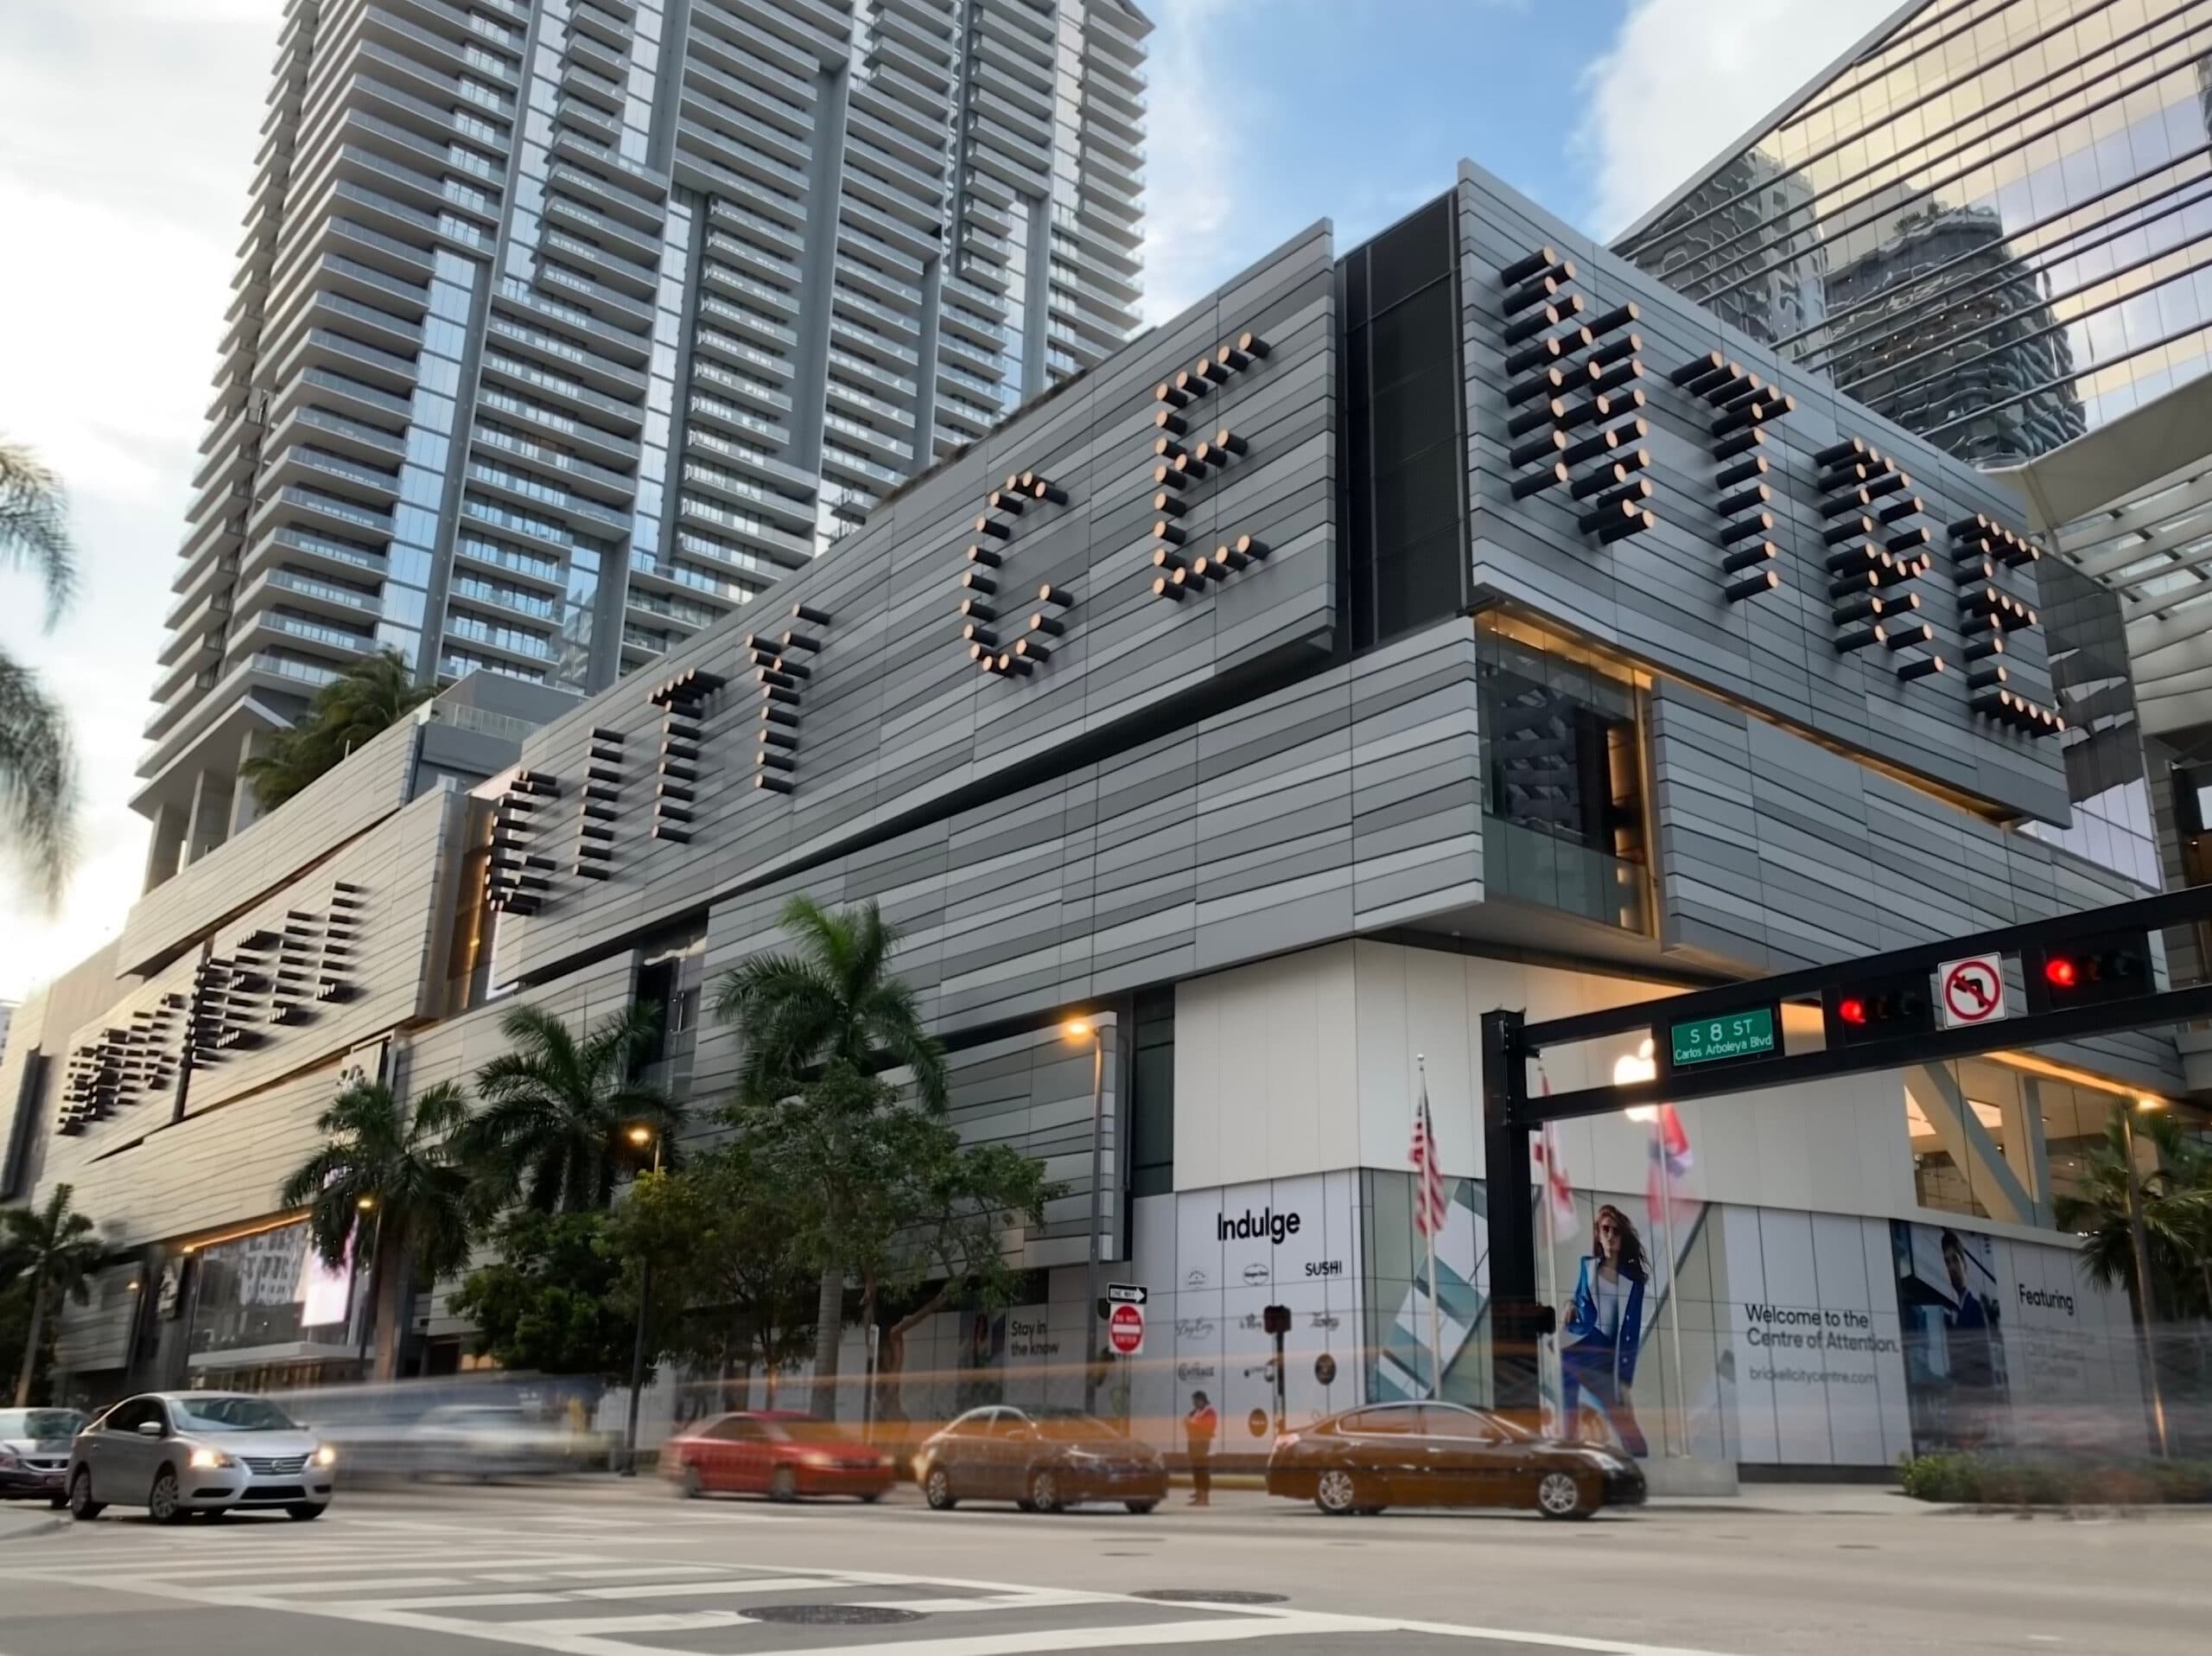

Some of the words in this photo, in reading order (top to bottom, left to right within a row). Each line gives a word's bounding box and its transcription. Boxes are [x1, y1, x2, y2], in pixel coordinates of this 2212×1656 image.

[1690, 1029, 1700, 1043] S
[1710, 1023, 1723, 1041] 8
[1733, 1019, 1753, 1036] ST
[1675, 1047, 1702, 1060] Carlos
[1706, 1040, 1747, 1054] Arboleya
[1750, 1035, 1771, 1048] Blvd
[1217, 1207, 1300, 1245] Indulge
[1305, 1260, 1342, 1277] SUSHI
[2018, 1283, 2075, 1316] Featuring
[1745, 1303, 1821, 1326] Welcome
[1825, 1310, 1840, 1327] to
[1844, 1309, 1869, 1328] the
[1012, 1320, 1035, 1341] Stay
[1037, 1320, 1046, 1335] in
[1747, 1327, 1803, 1348] Centre
[1807, 1330, 1823, 1349] of
[1826, 1332, 1900, 1353] Attention.
[1011, 1341, 1028, 1356] the
[1029, 1341, 1059, 1356] know
